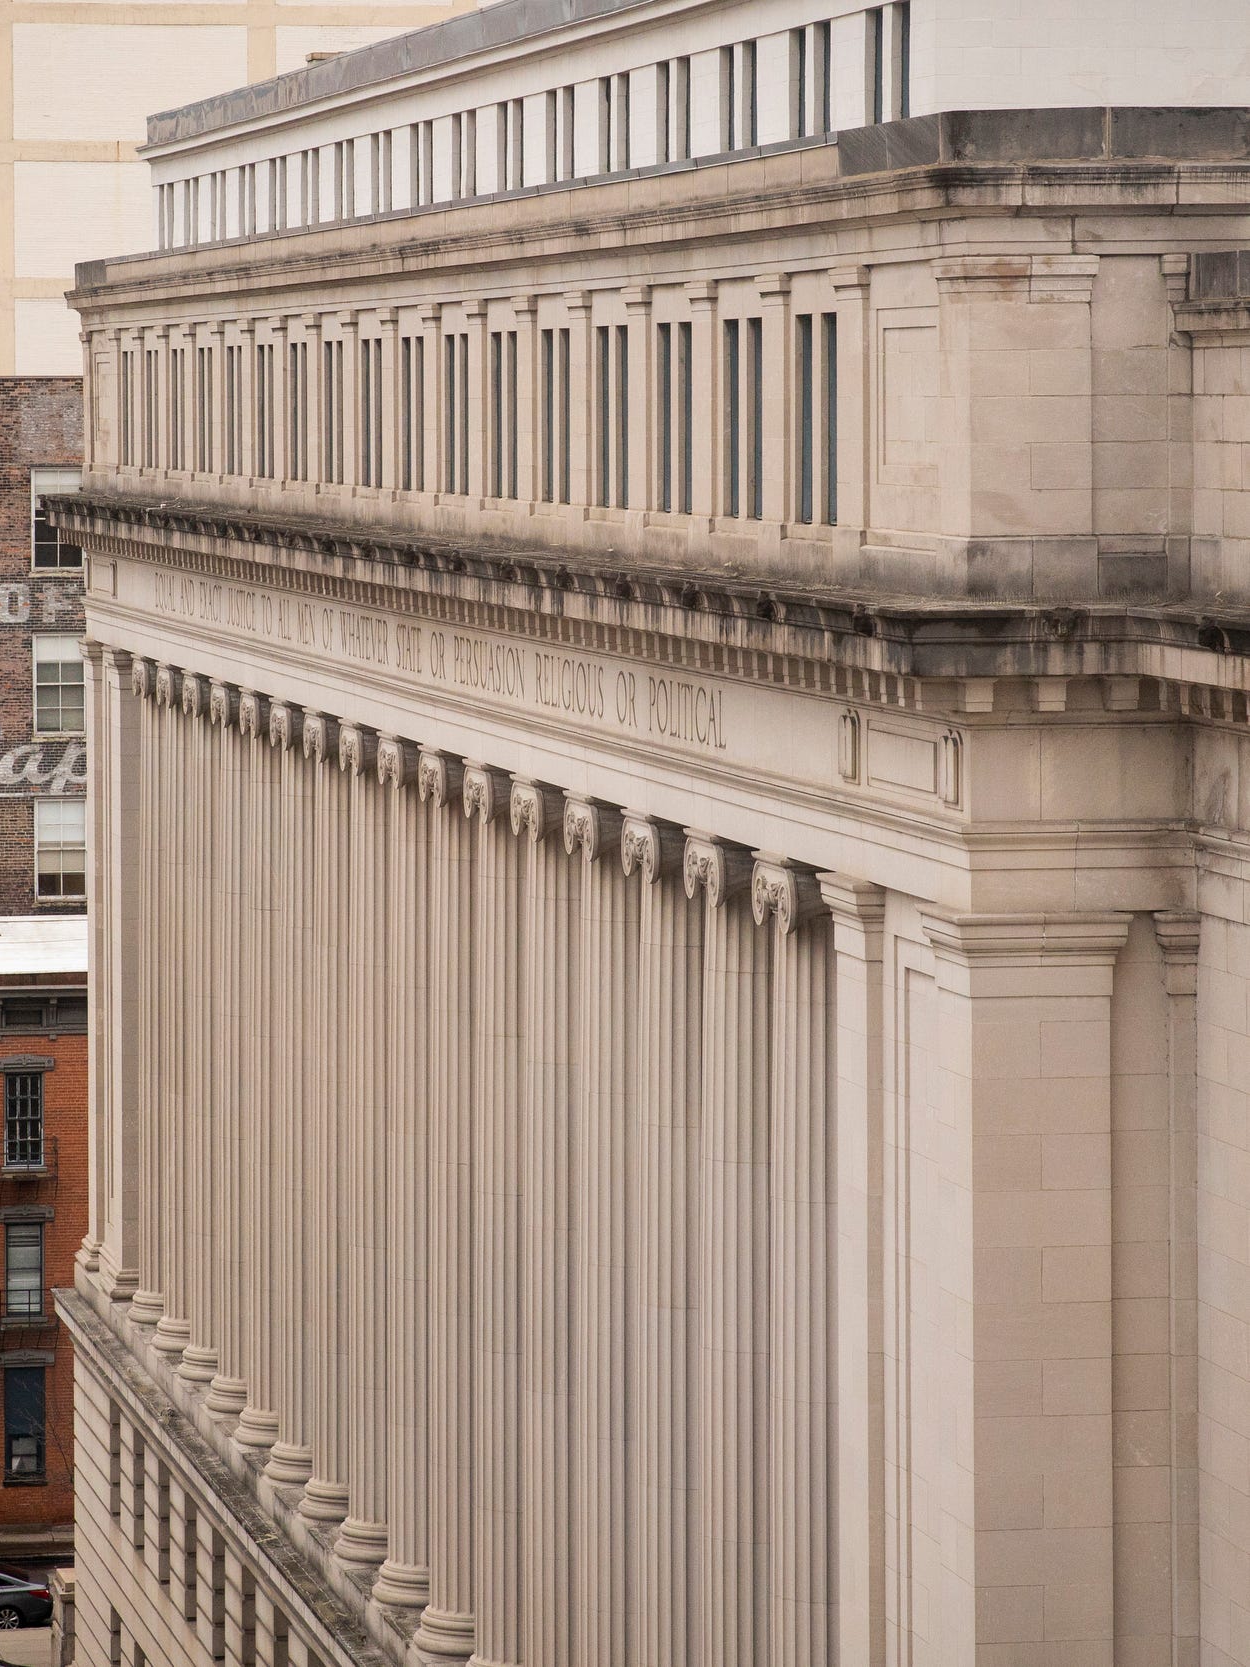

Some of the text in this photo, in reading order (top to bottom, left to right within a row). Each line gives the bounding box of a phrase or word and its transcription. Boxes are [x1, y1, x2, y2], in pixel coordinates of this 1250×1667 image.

[155, 572, 727, 750] EQUAL AND EXACT JUSTICE TO ALL MEN OF WHATEVER STATE OR PERSUASION RELIGIOUS OR POLITICAL
